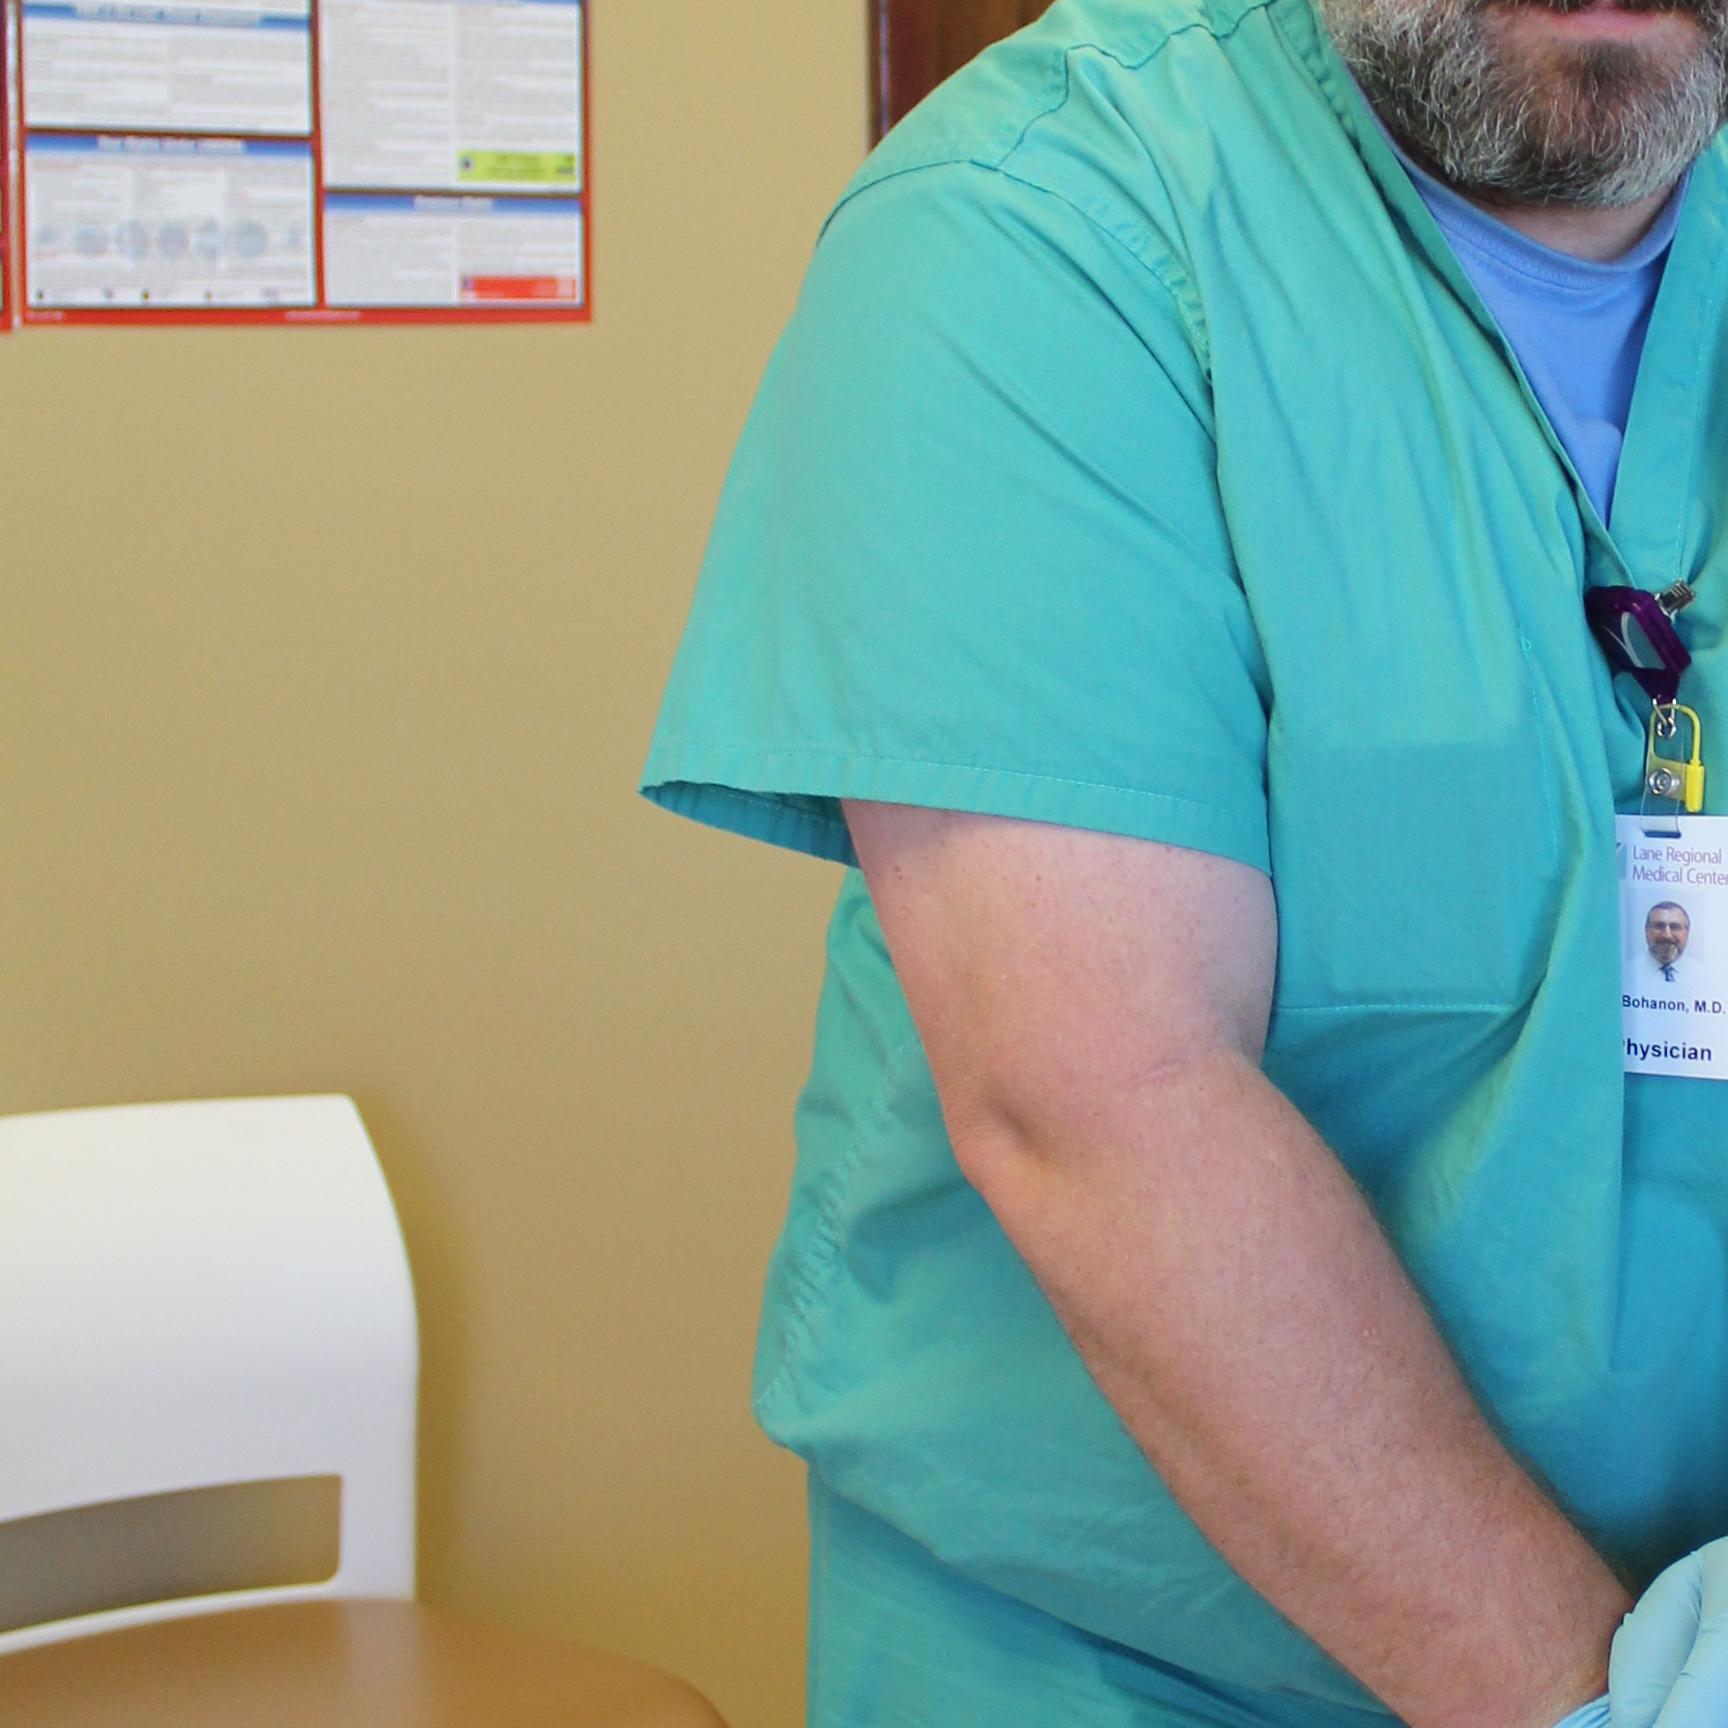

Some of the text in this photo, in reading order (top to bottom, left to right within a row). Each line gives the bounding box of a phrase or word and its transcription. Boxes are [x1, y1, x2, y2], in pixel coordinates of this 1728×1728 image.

[1632, 845, 1723, 865] Lane Regional
[1632, 866, 1683, 884] Medical
[1622, 995, 1727, 1015] Bohanon, M.D.
[1623, 1038, 1713, 1063] hysician
